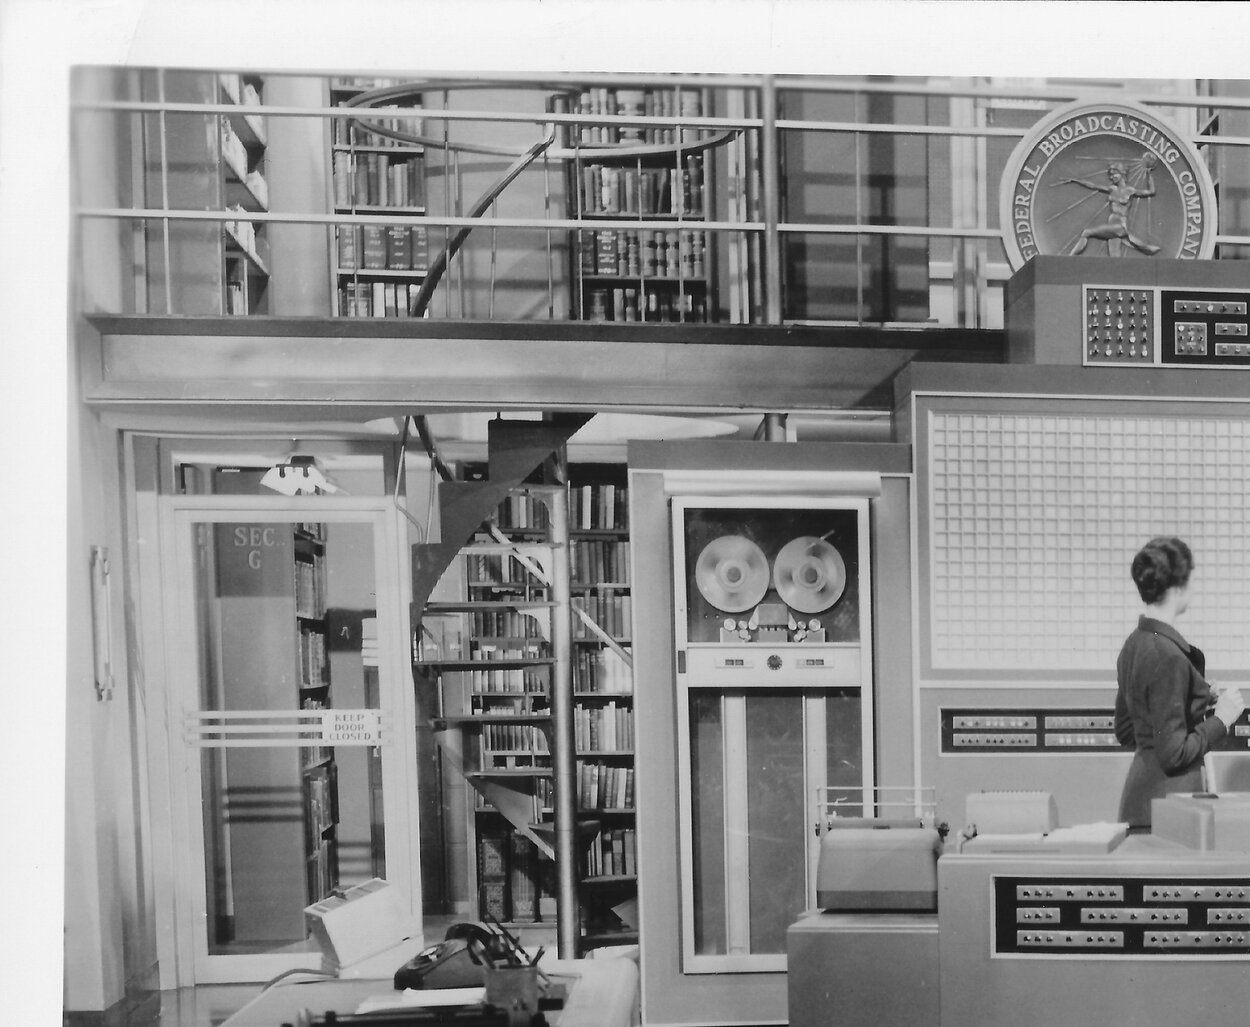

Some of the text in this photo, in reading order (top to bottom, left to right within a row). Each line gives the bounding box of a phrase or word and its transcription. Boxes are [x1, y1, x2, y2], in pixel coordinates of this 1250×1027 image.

[1014, 164, 1041, 261] FEDERAL
[1038, 115, 1180, 163] BROADCASTING
[334, 714, 365, 722] KEEP
[334, 723, 365, 731] DOOR
[329, 732, 371, 741] CLOSED
